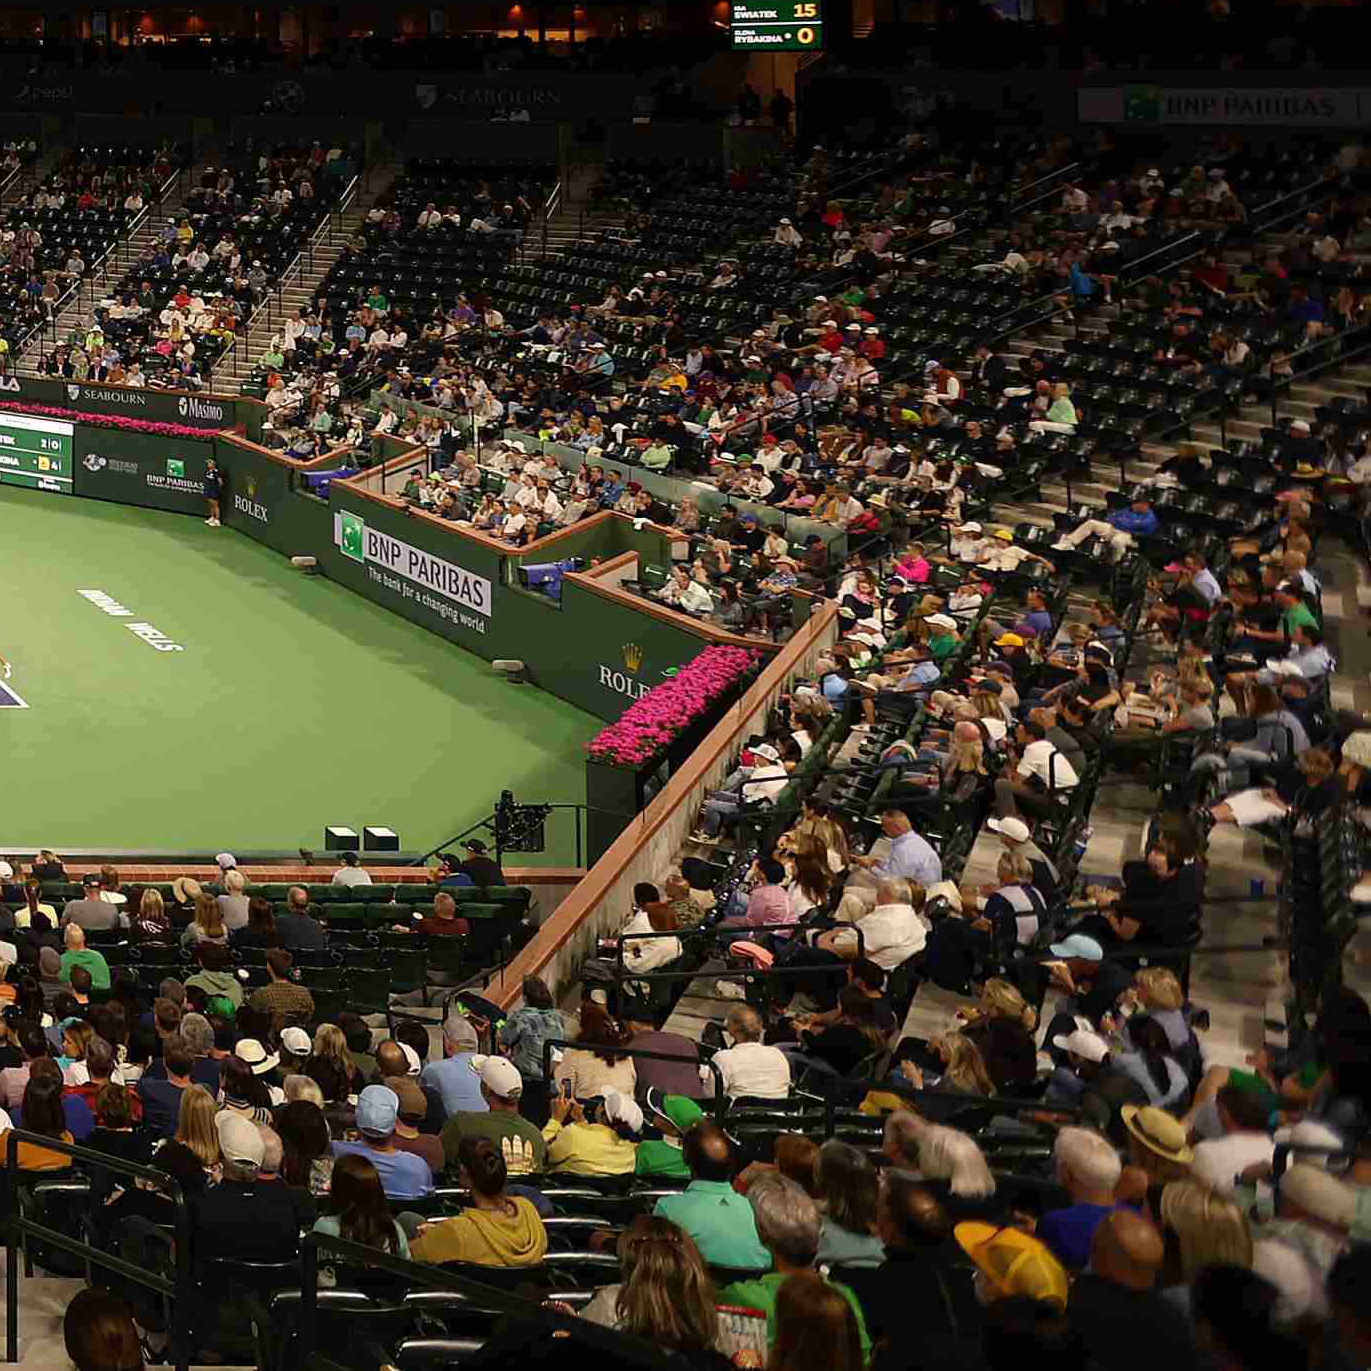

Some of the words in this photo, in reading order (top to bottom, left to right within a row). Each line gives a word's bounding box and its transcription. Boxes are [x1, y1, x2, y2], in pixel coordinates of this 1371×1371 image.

[734, 10, 778, 19] SWIATEK
[794, 3, 816, 18] 15
[734, 35, 783, 44] RYBAKINA
[798, 27, 814, 44] 0
[84, 389, 147, 406] SEABOURN
[51, 441, 59, 450] 0
[234, 495, 268, 522] ROLEX
[369, 532, 401, 566] BNP
[409, 549, 484, 607] PARIBAS
[369, 567, 382, 583] The
[383, 573, 402, 593] bank
[402, 582, 414, 598] for
[422, 593, 459, 624] changing
[460, 614, 485, 634] world
[123, 622, 185, 651] WELLS
